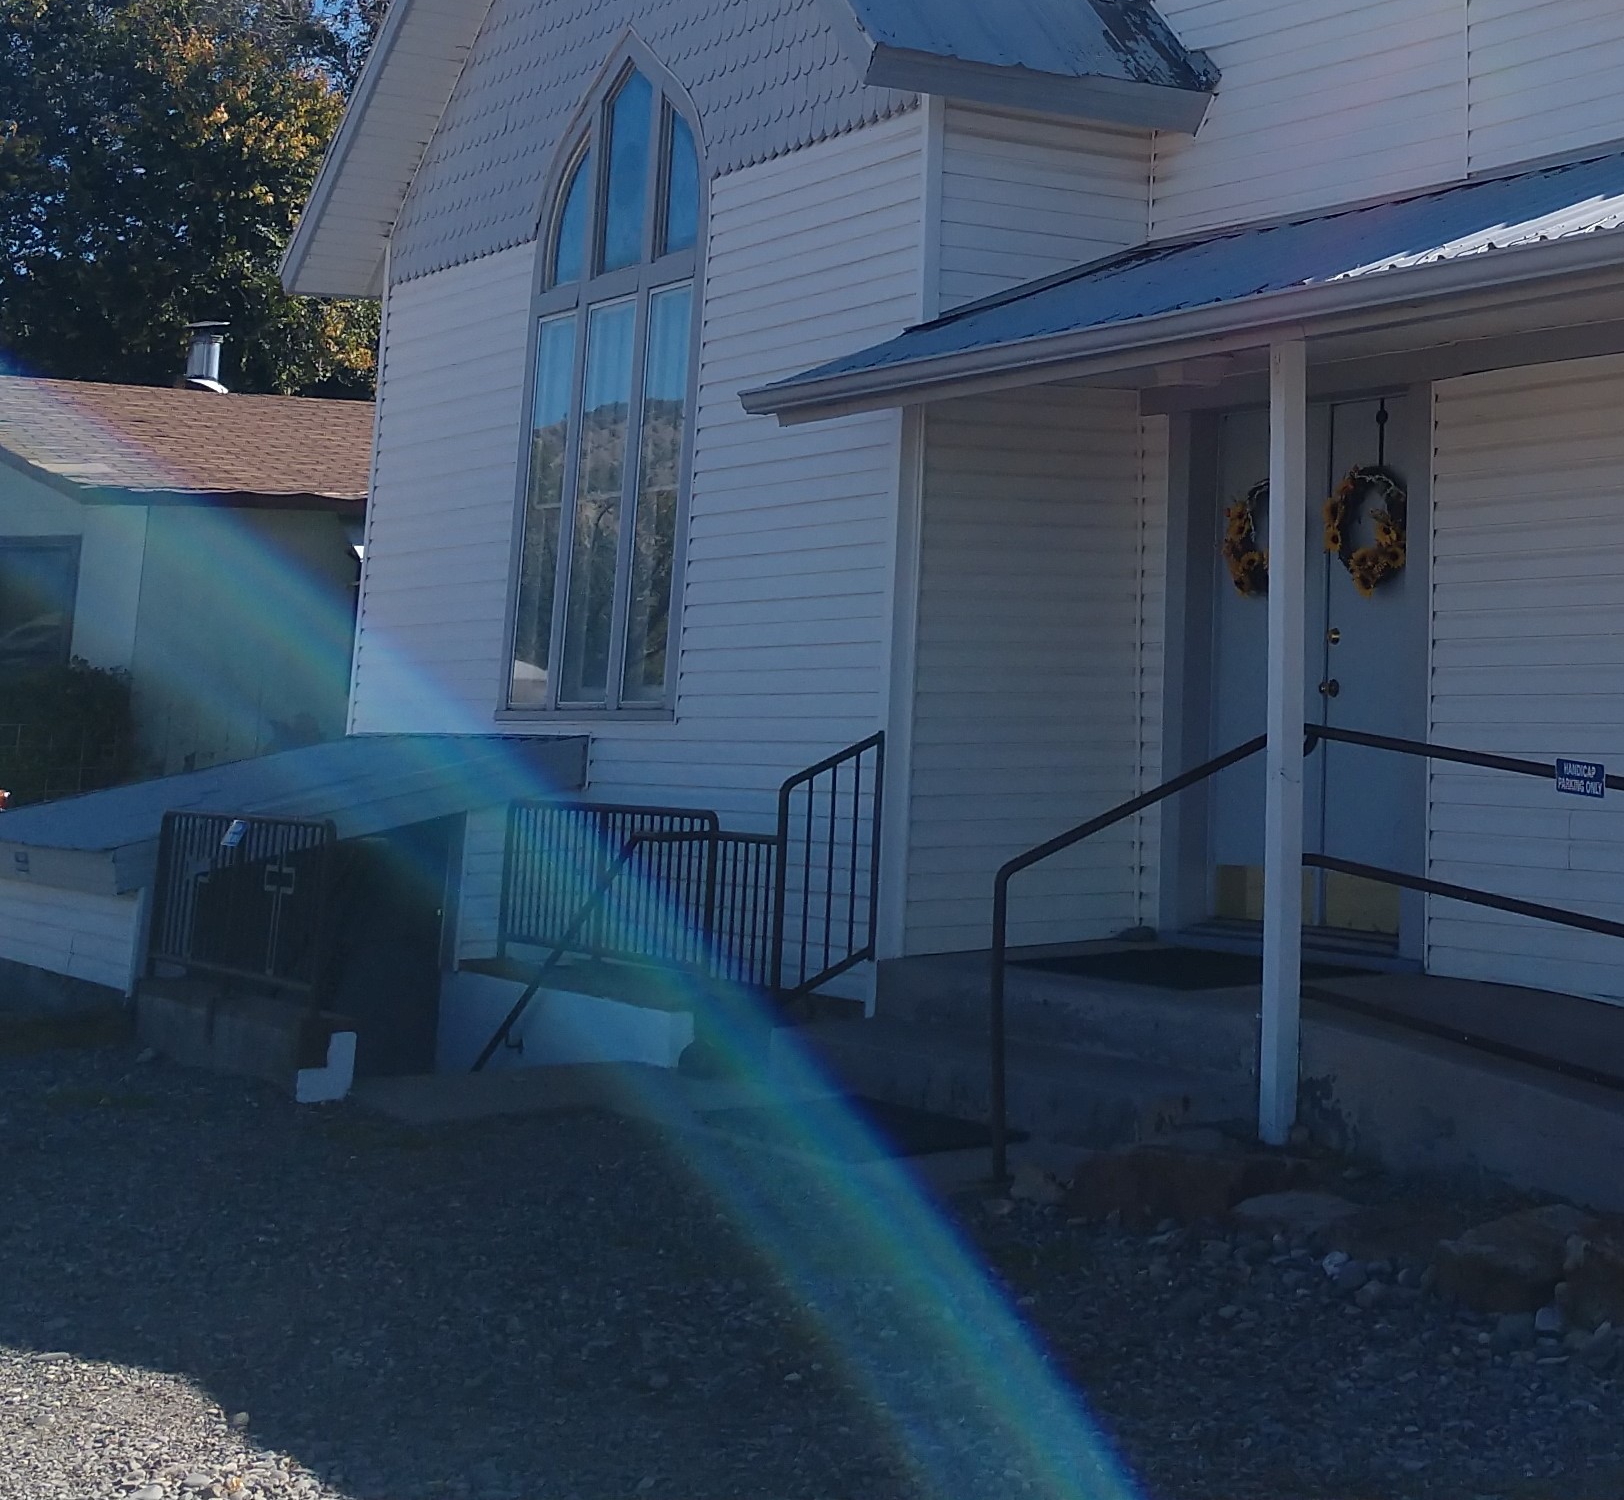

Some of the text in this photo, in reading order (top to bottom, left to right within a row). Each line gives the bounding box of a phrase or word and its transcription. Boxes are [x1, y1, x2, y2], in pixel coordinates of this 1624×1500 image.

[1563, 762, 1596, 778] HANDICAP
[1558, 777, 1602, 795] PARKING ONLY
